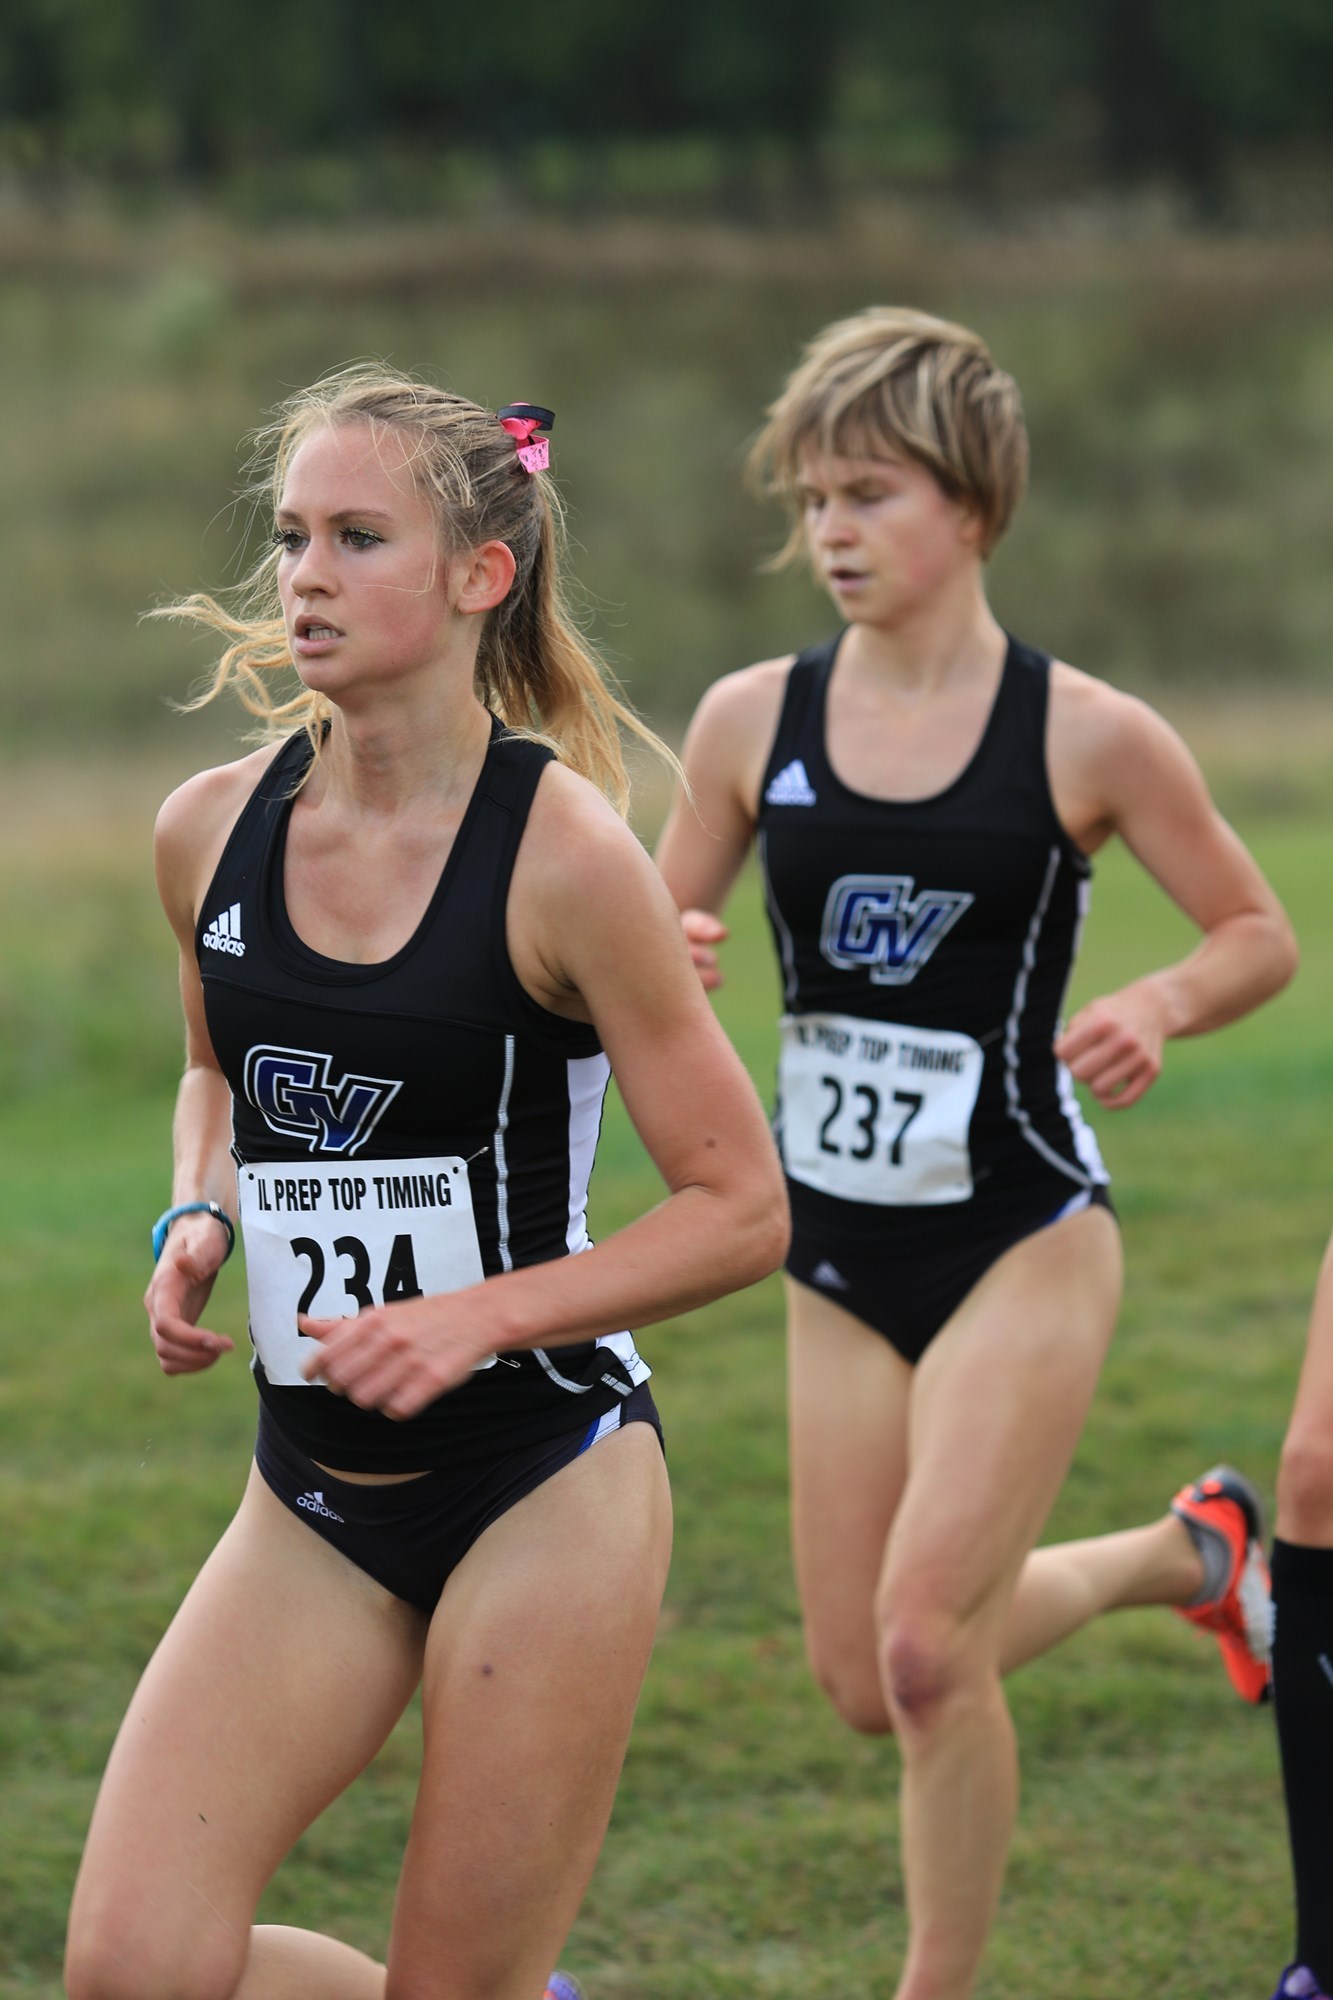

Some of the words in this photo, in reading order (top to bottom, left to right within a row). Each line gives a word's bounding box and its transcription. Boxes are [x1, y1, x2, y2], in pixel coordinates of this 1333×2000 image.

[202, 931, 246, 957] adidas
[820, 874, 976, 985] GV
[243, 1044, 404, 1157] GV
[819, 1076, 924, 1165] 237
[257, 1178, 272, 1211] IL
[274, 1178, 322, 1212] PREP
[328, 1177, 367, 1211] TOP
[372, 1172, 453, 1210] TIMING
[289, 1233, 425, 1338] 234
